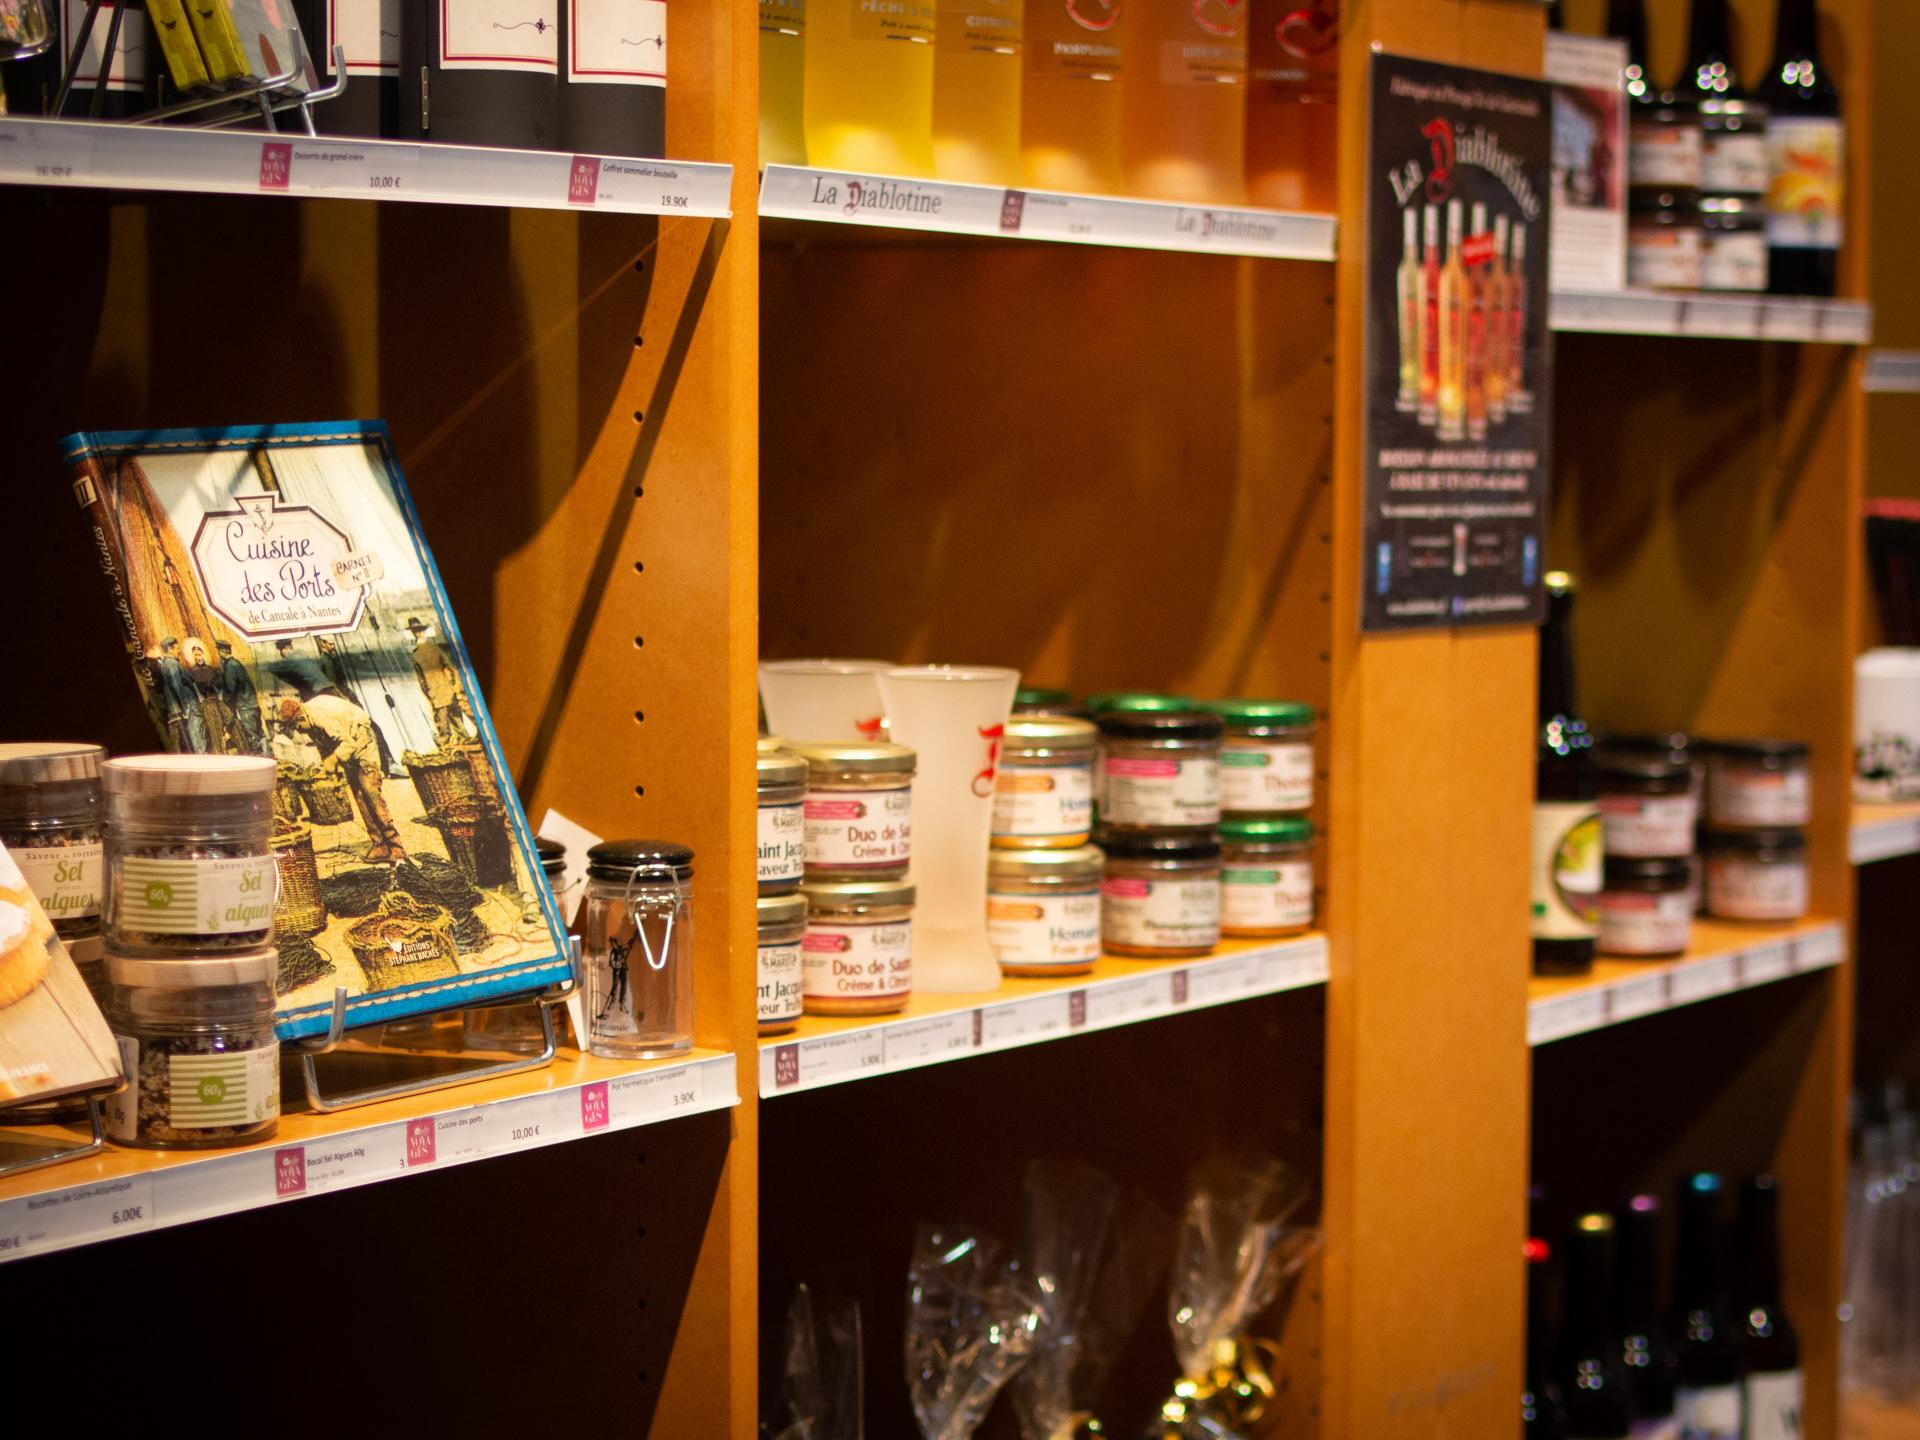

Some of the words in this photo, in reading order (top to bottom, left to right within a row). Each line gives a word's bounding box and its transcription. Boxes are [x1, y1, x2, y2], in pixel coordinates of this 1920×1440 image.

[603, 163, 622, 174] Coffret
[623, 166, 653, 177] sommelier
[653, 169, 678, 180] bouteille
[369, 176, 393, 189] 10,00
[394, 177, 401, 188] €
[661, 195, 689, 209] 19.90€
[812, 176, 838, 205] La
[843, 180, 942, 217] Diablotine
[226, 520, 314, 563] Cuisine
[336, 555, 372, 575] CARNET
[241, 570, 275, 605] des
[278, 559, 336, 601] Ports
[248, 611, 261, 625] de
[261, 607, 300, 624] Cancale
[301, 607, 307, 619] à
[309, 605, 342, 619] Nantes
[848, 826, 877, 843] Duo
[881, 825, 896, 841] de
[25, 852, 60, 860] Saveur
[757, 842, 780, 859] aint
[853, 844, 887, 859] Crème
[54, 860, 84, 884] Sel
[758, 864, 789, 876] aveur
[238, 868, 264, 893] Sel
[40, 892, 94, 916] algues
[225, 903, 269, 927] algues
[832, 959, 863, 976] Duo
[867, 957, 886, 975] de
[836, 977, 874, 992] Crème
[674, 1091, 695, 1106] 3.90€
[438, 1120, 457, 1130] Cuisine
[458, 1117, 468, 1127] des
[469, 1115, 483, 1126] ports
[512, 1126, 534, 1141] 10,00
[535, 1125, 541, 1136] €
[307, 1156, 323, 1167] Bocal
[323, 1154, 333, 1162] Sel
[334, 1151, 353, 1162] Algues
[354, 1148, 365, 1157] 60g
[112, 1206, 143, 1225] 6.00€
